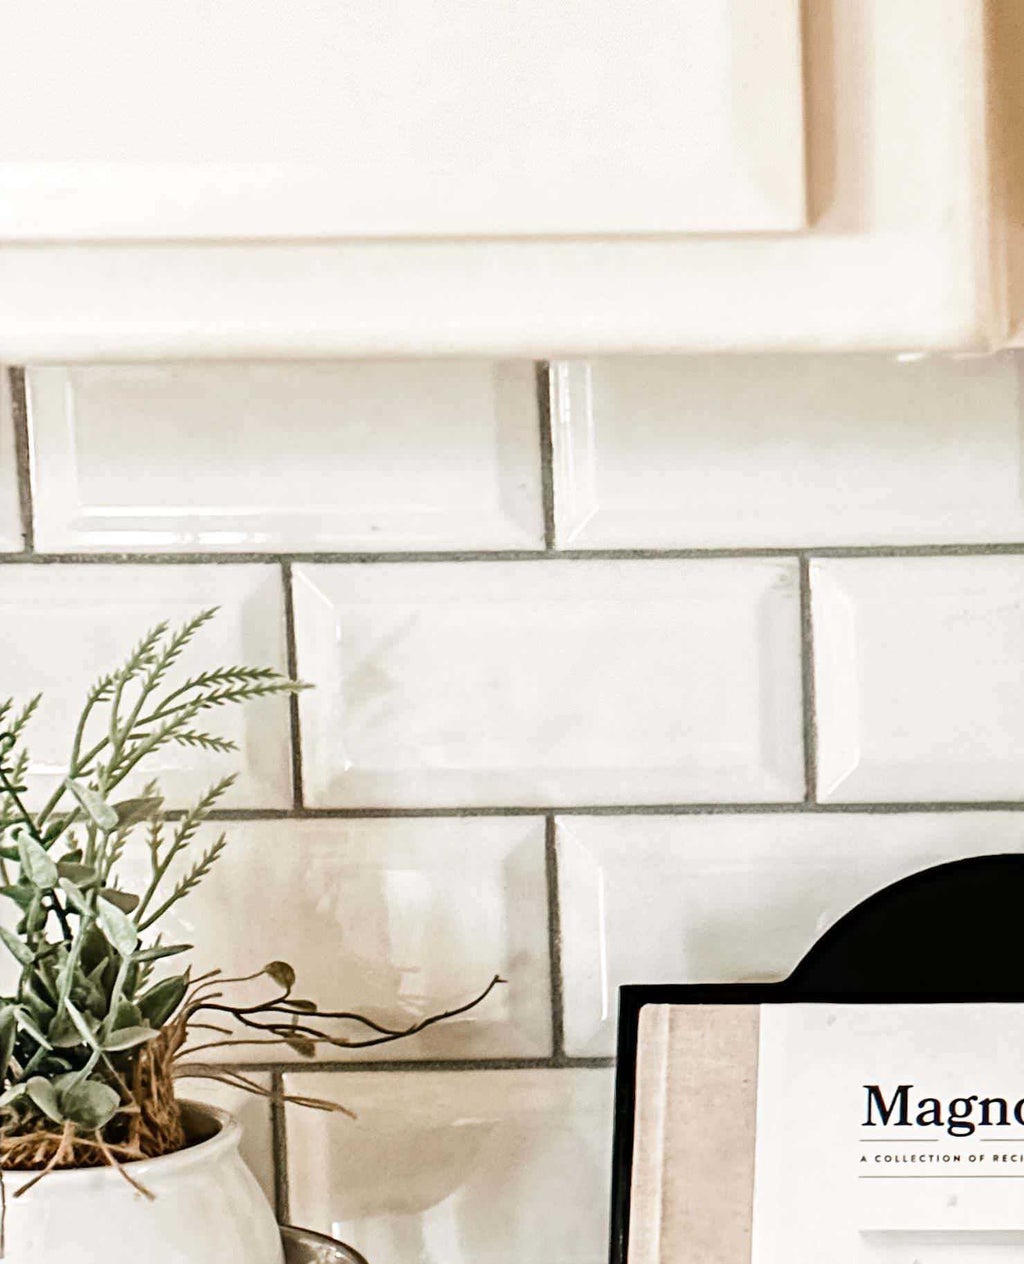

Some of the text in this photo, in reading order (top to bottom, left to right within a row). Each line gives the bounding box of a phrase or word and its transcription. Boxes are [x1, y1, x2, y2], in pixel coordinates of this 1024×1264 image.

[860, 1155, 868, 1163] A
[874, 1154, 962, 1163] COLLECTION
[968, 1154, 986, 1163] OF
